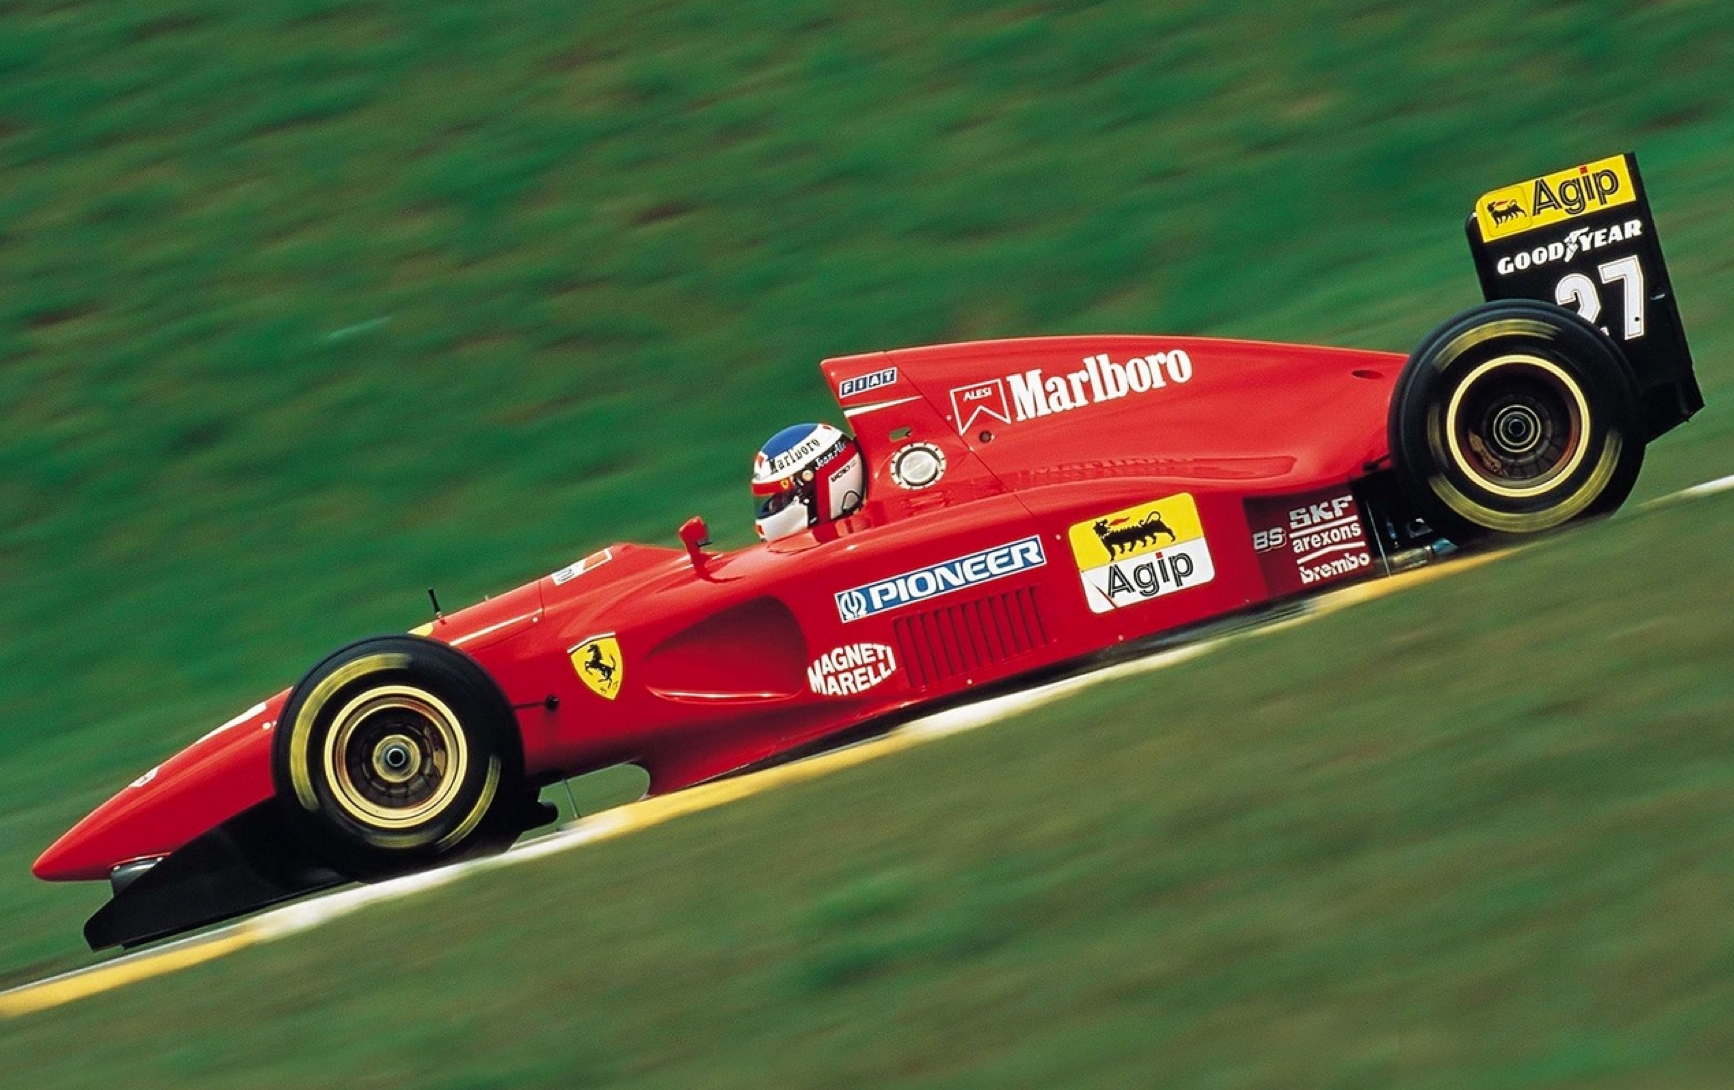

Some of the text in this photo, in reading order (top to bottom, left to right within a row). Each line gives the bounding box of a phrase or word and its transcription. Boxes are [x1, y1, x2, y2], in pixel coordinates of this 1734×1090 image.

[1532, 166, 1619, 216] Agip
[1497, 219, 1643, 275] GOODYEAR
[1555, 254, 1645, 341] 27
[841, 368, 896, 397] FIAT
[963, 386, 992, 402] ALESI
[1006, 349, 1192, 422] Marlboro
[1289, 494, 1353, 530] SKF
[1253, 527, 1287, 553] BS
[1293, 523, 1362, 553] arexons
[868, 540, 1045, 610] PIONEER
[1107, 551, 1195, 598] Agip
[1299, 552, 1370, 585] brembo
